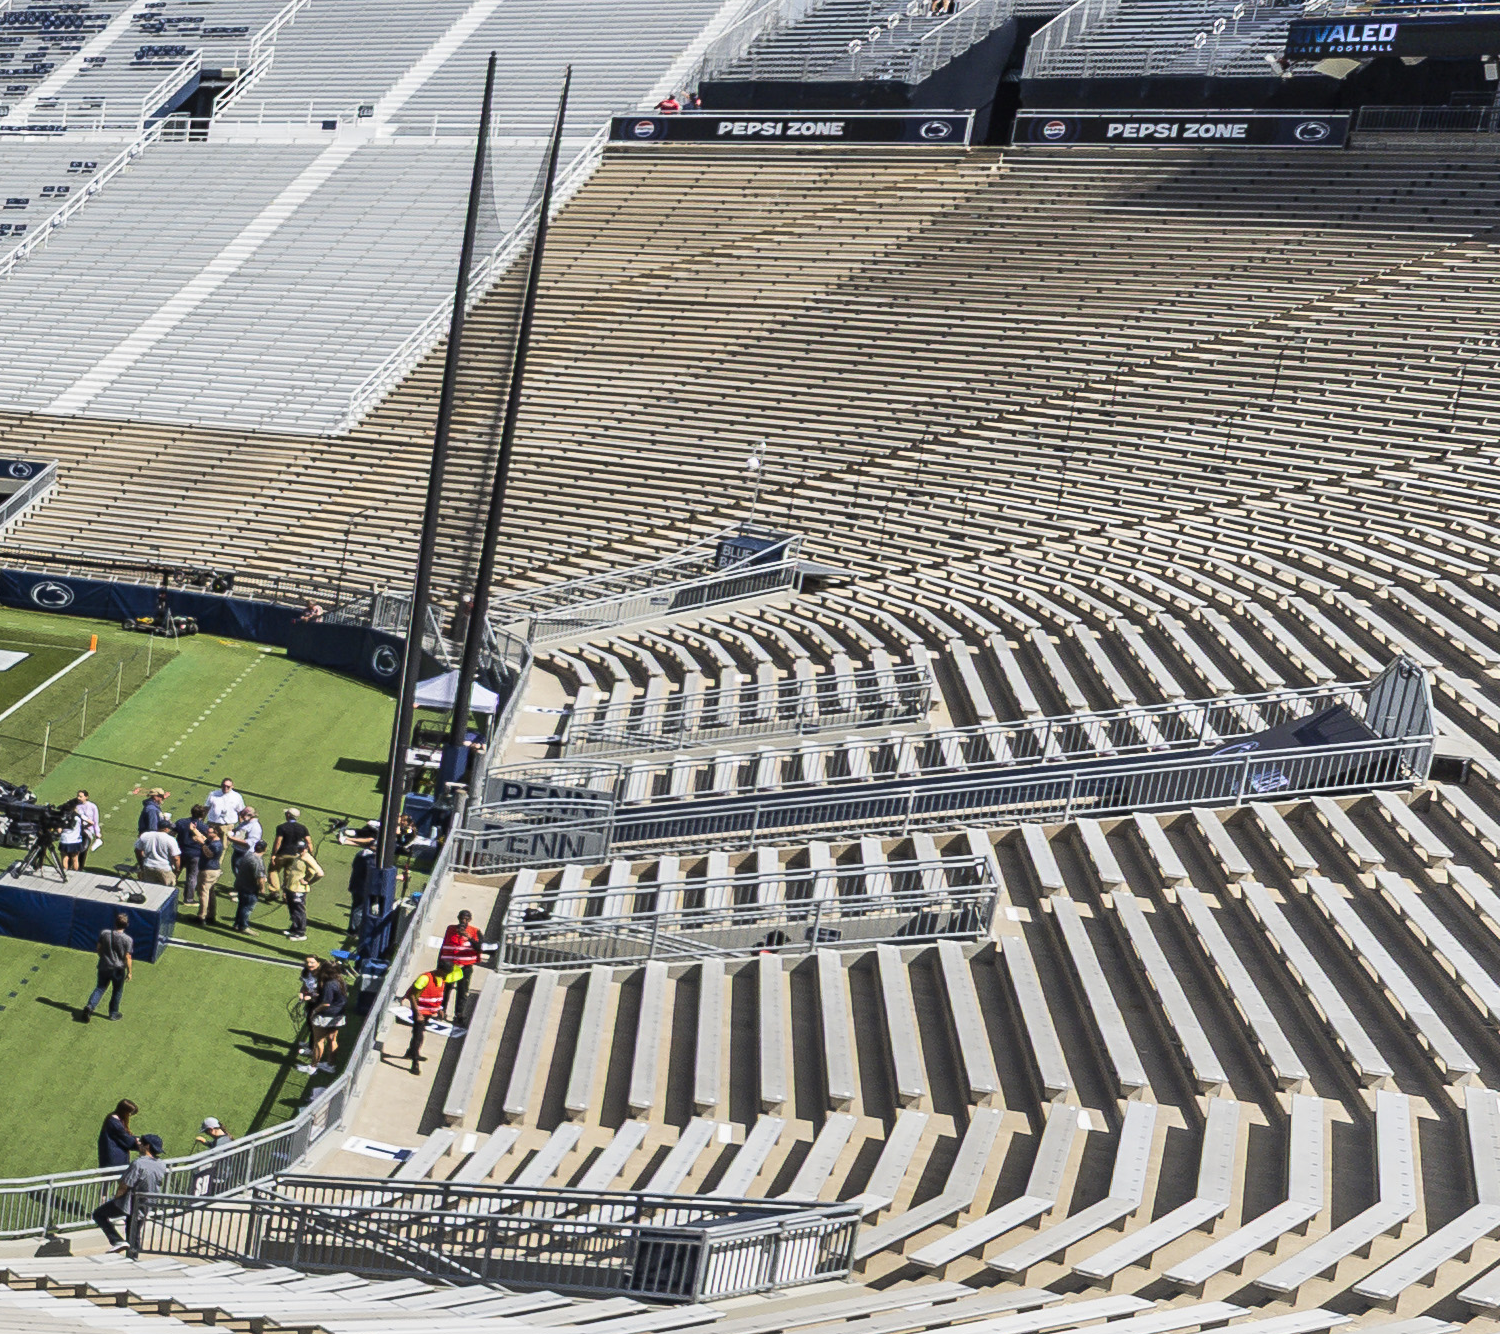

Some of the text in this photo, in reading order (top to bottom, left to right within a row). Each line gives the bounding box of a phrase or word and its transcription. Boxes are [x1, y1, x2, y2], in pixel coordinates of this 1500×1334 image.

[717, 122, 845, 135] PEPSI ZONE
[1107, 124, 1248, 138] PEPSI ZONE
[483, 824, 586, 858] PENN
